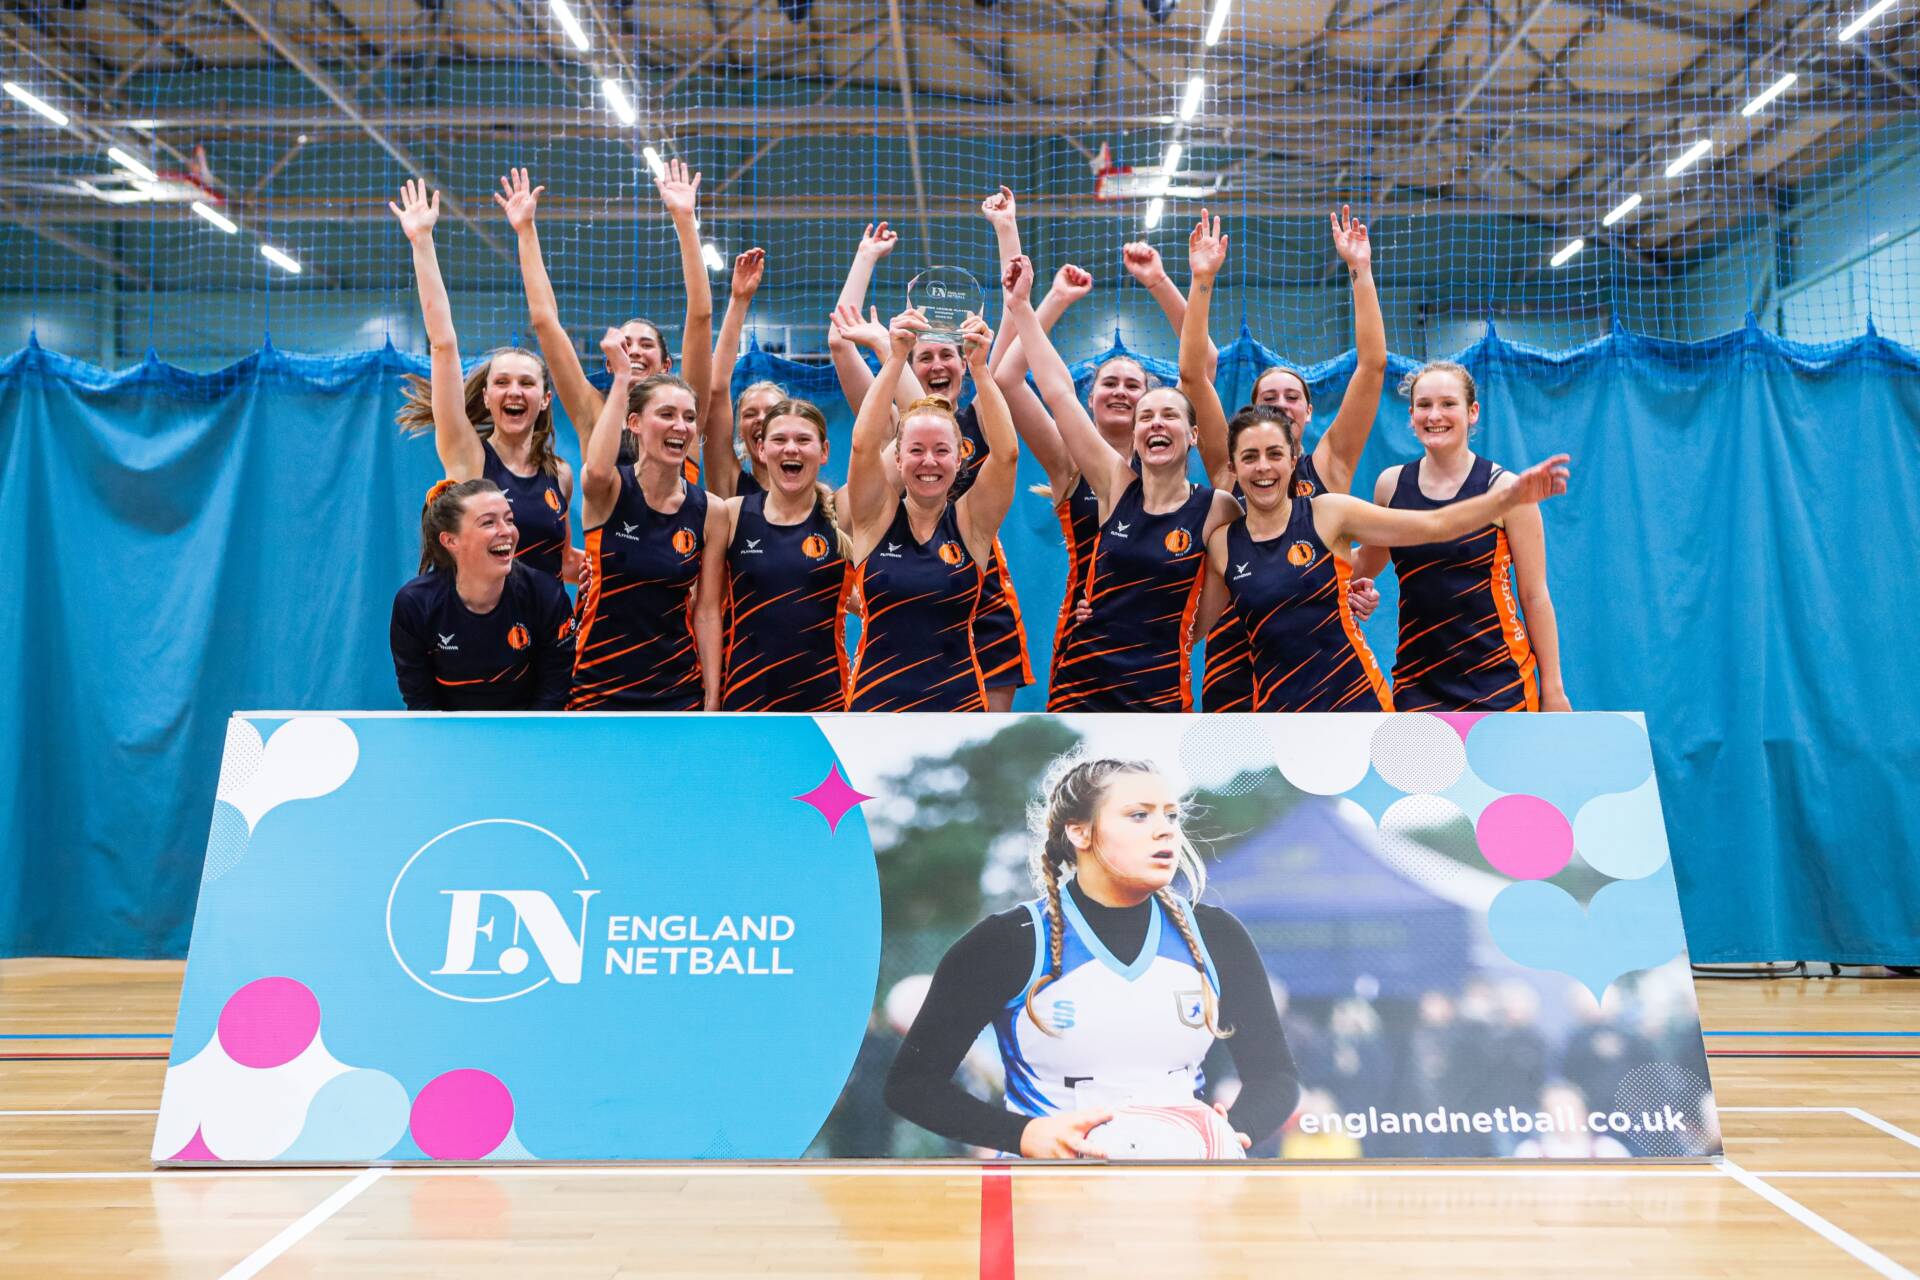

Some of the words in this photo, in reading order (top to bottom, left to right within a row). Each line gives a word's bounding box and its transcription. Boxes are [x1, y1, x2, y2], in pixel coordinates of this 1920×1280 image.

[607, 915, 796, 942] ENGLAND
[604, 946, 794, 975] NETBALL
[1299, 1105, 1687, 1138] englandnetball.co.uk
